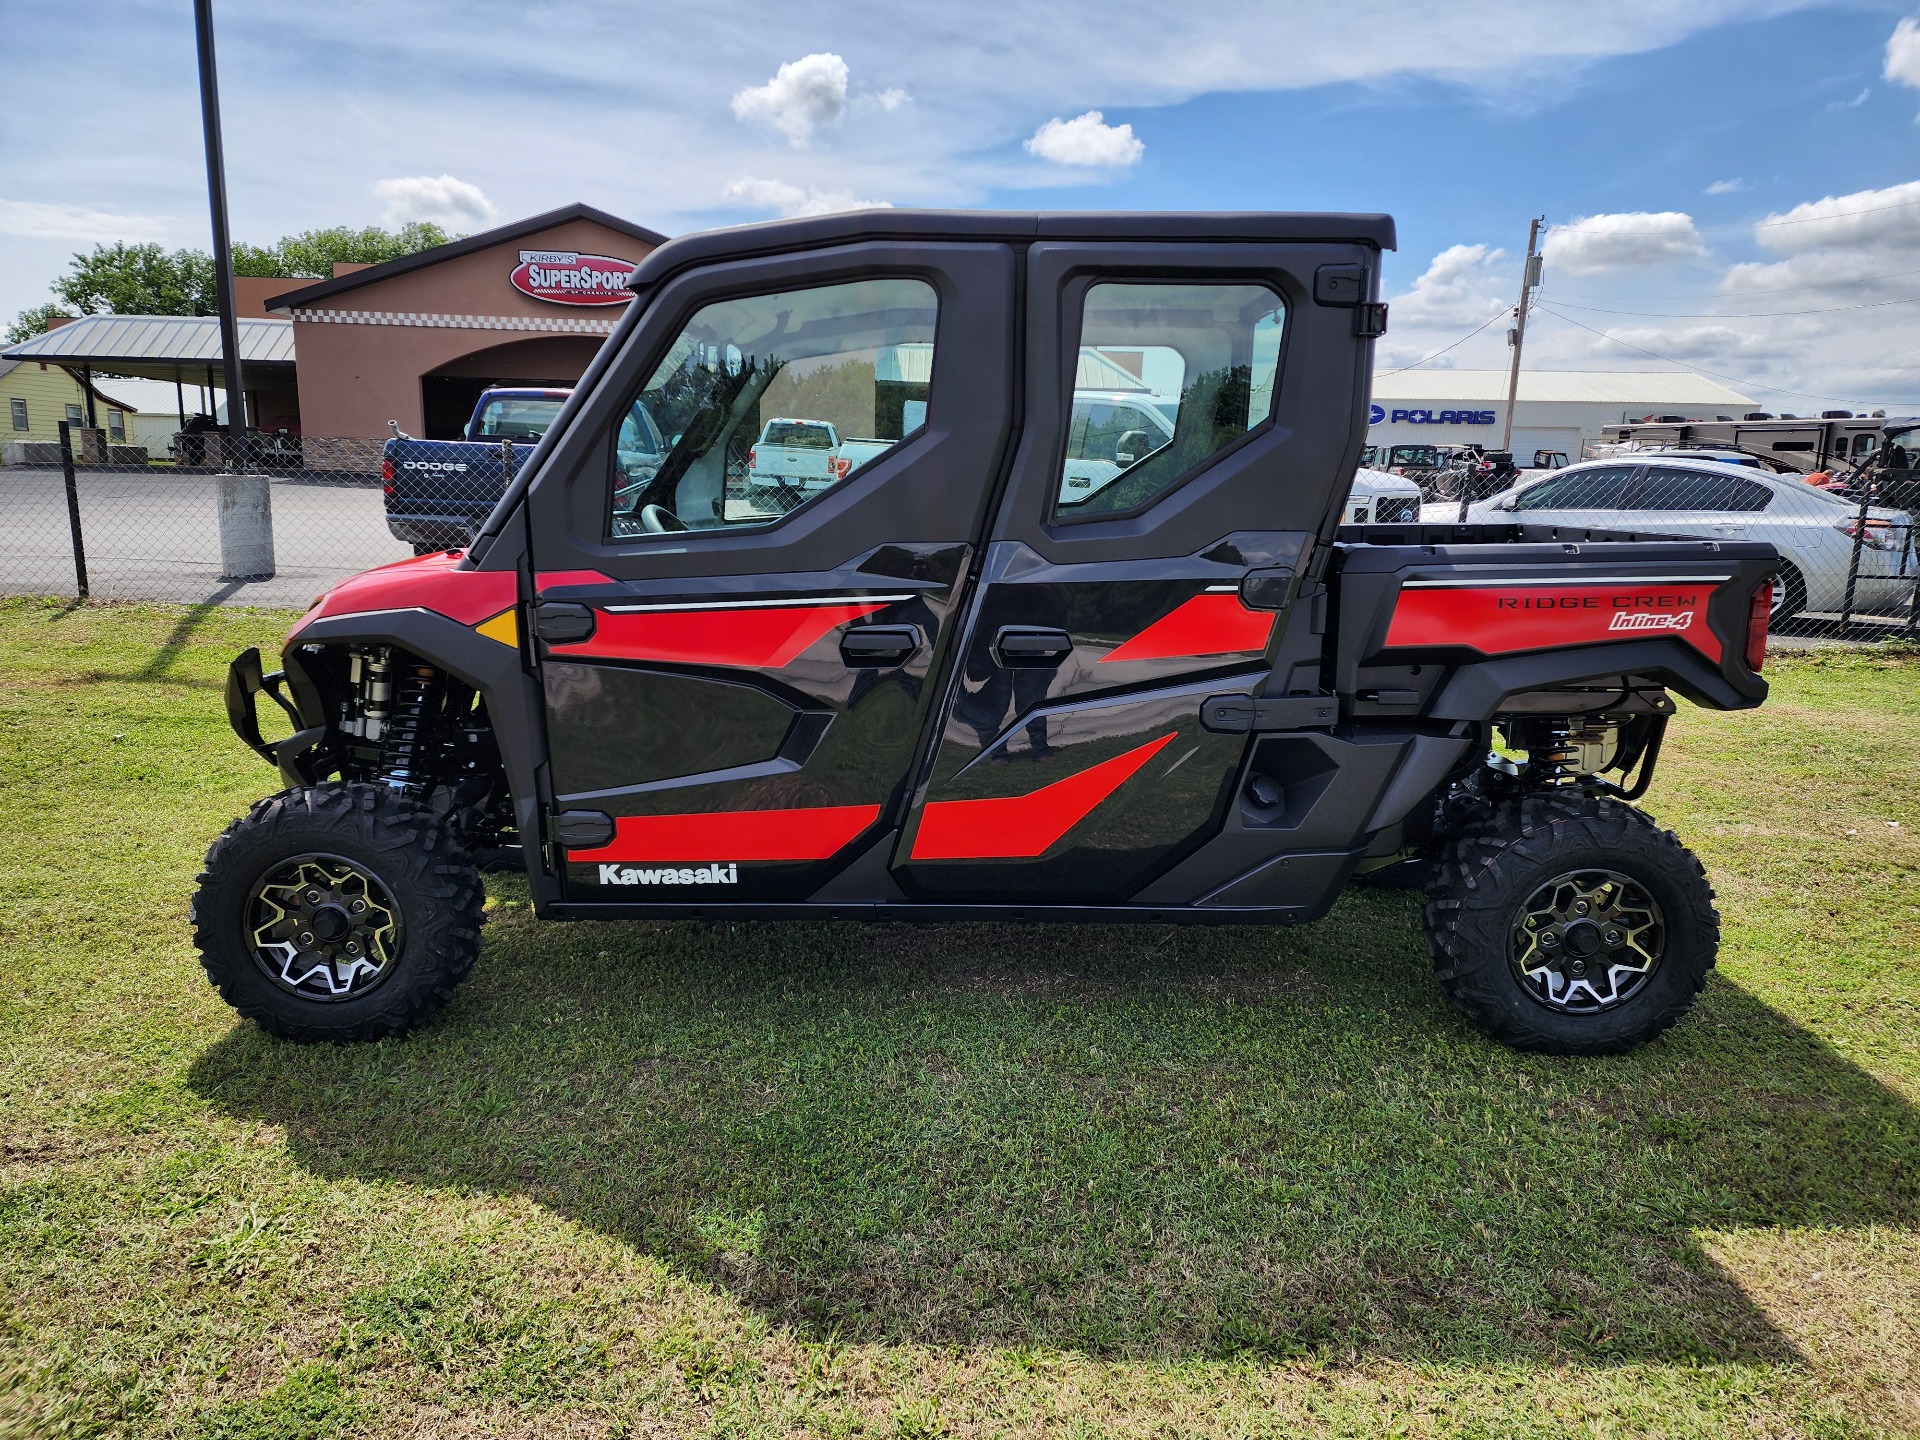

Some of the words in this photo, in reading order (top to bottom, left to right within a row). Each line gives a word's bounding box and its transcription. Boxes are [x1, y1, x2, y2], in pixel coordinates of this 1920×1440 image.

[529, 254, 575, 264] KIRBY'S
[1391, 409, 1496, 424] POLARIS
[403, 461, 468, 472] DODGE
[1498, 596, 1600, 609] RIDGE
[1612, 595, 1697, 608] CREW
[1608, 611, 1694, 631] Inline-4
[598, 863, 738, 885] Kawasaki
